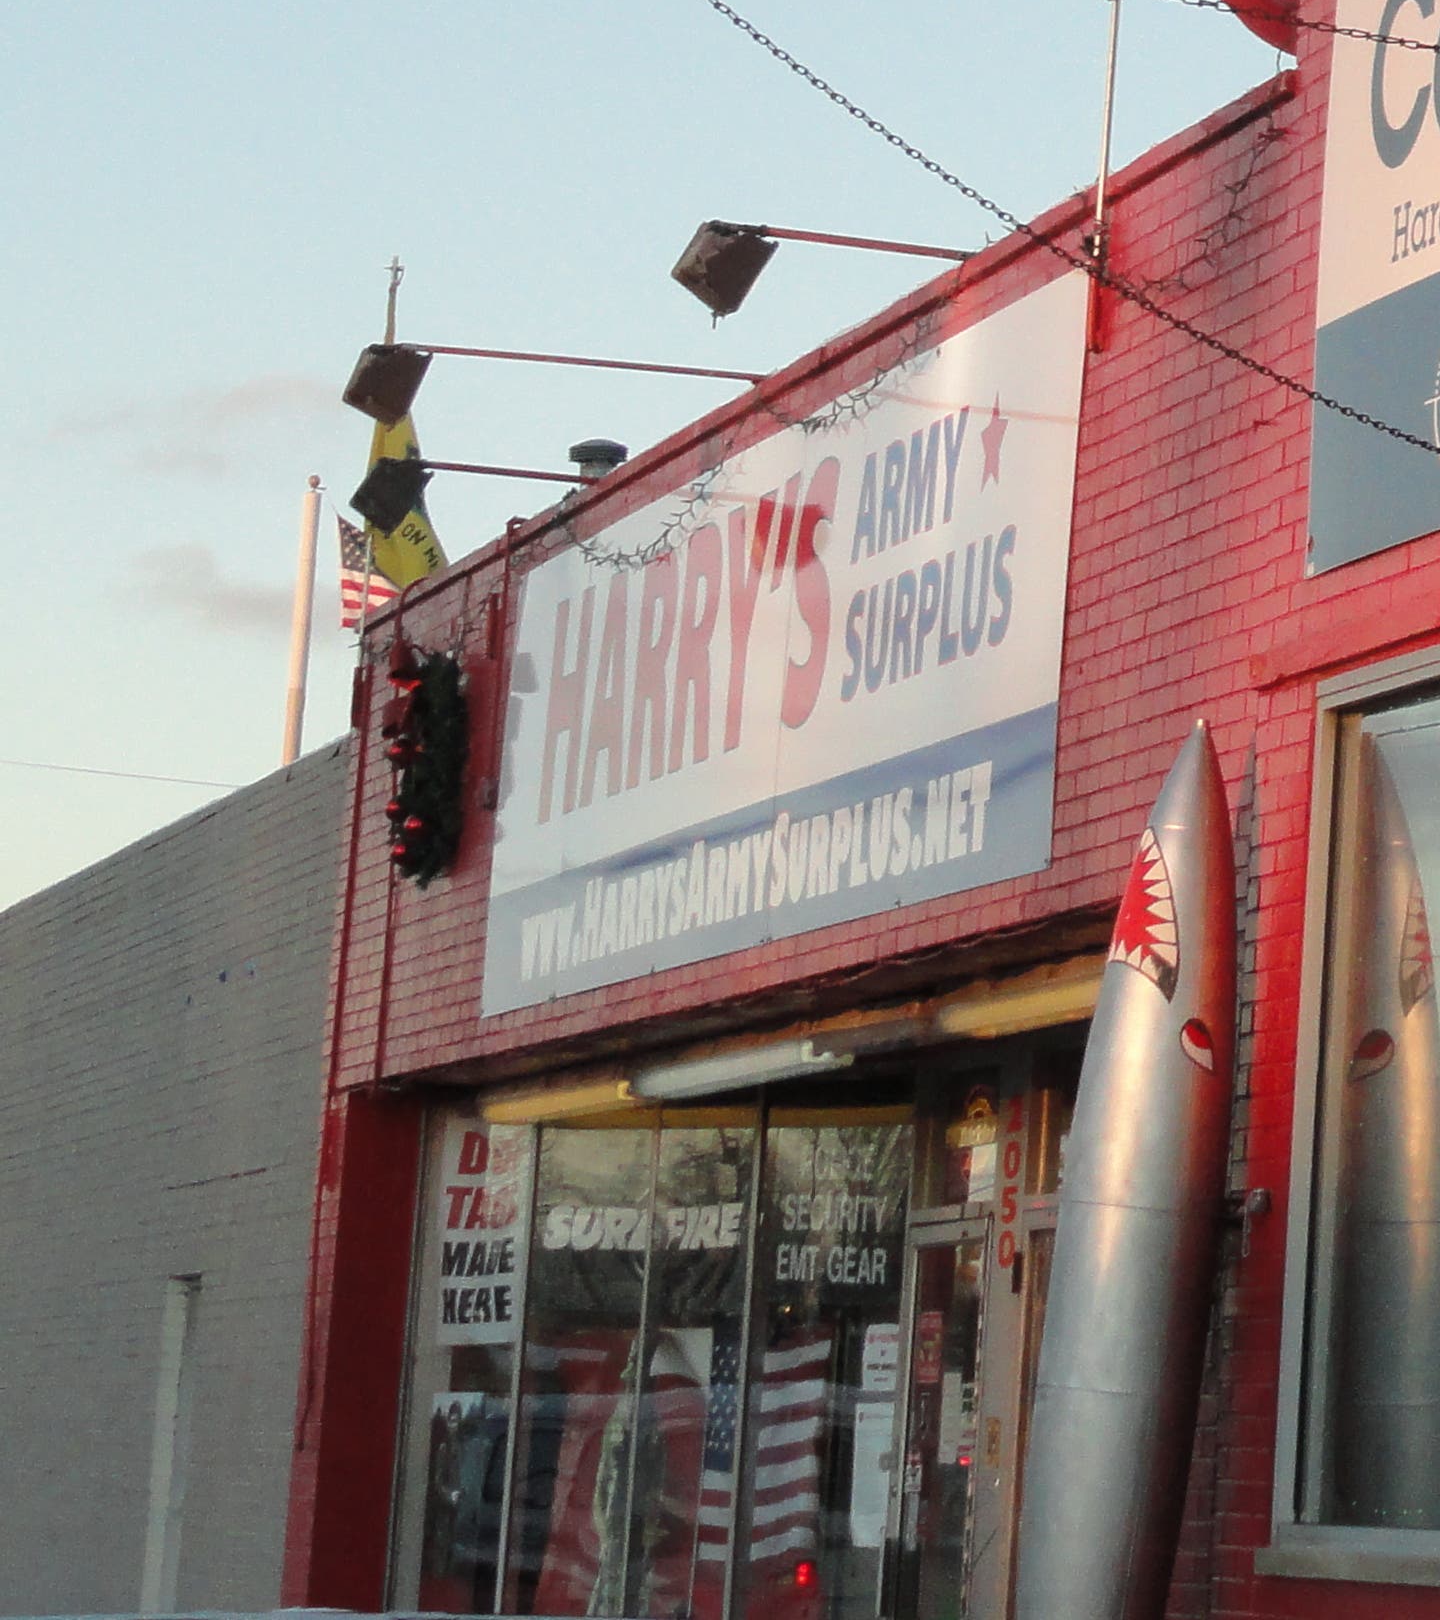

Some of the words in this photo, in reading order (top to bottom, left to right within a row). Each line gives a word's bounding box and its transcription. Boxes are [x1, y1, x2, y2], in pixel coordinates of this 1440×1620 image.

[423, 546, 440, 569] M
[849, 404, 972, 566] ARMY
[538, 455, 841, 824] HARRY'S
[839, 523, 1018, 703] SURPLUS
[826, 1245, 888, 1285] GEAR
